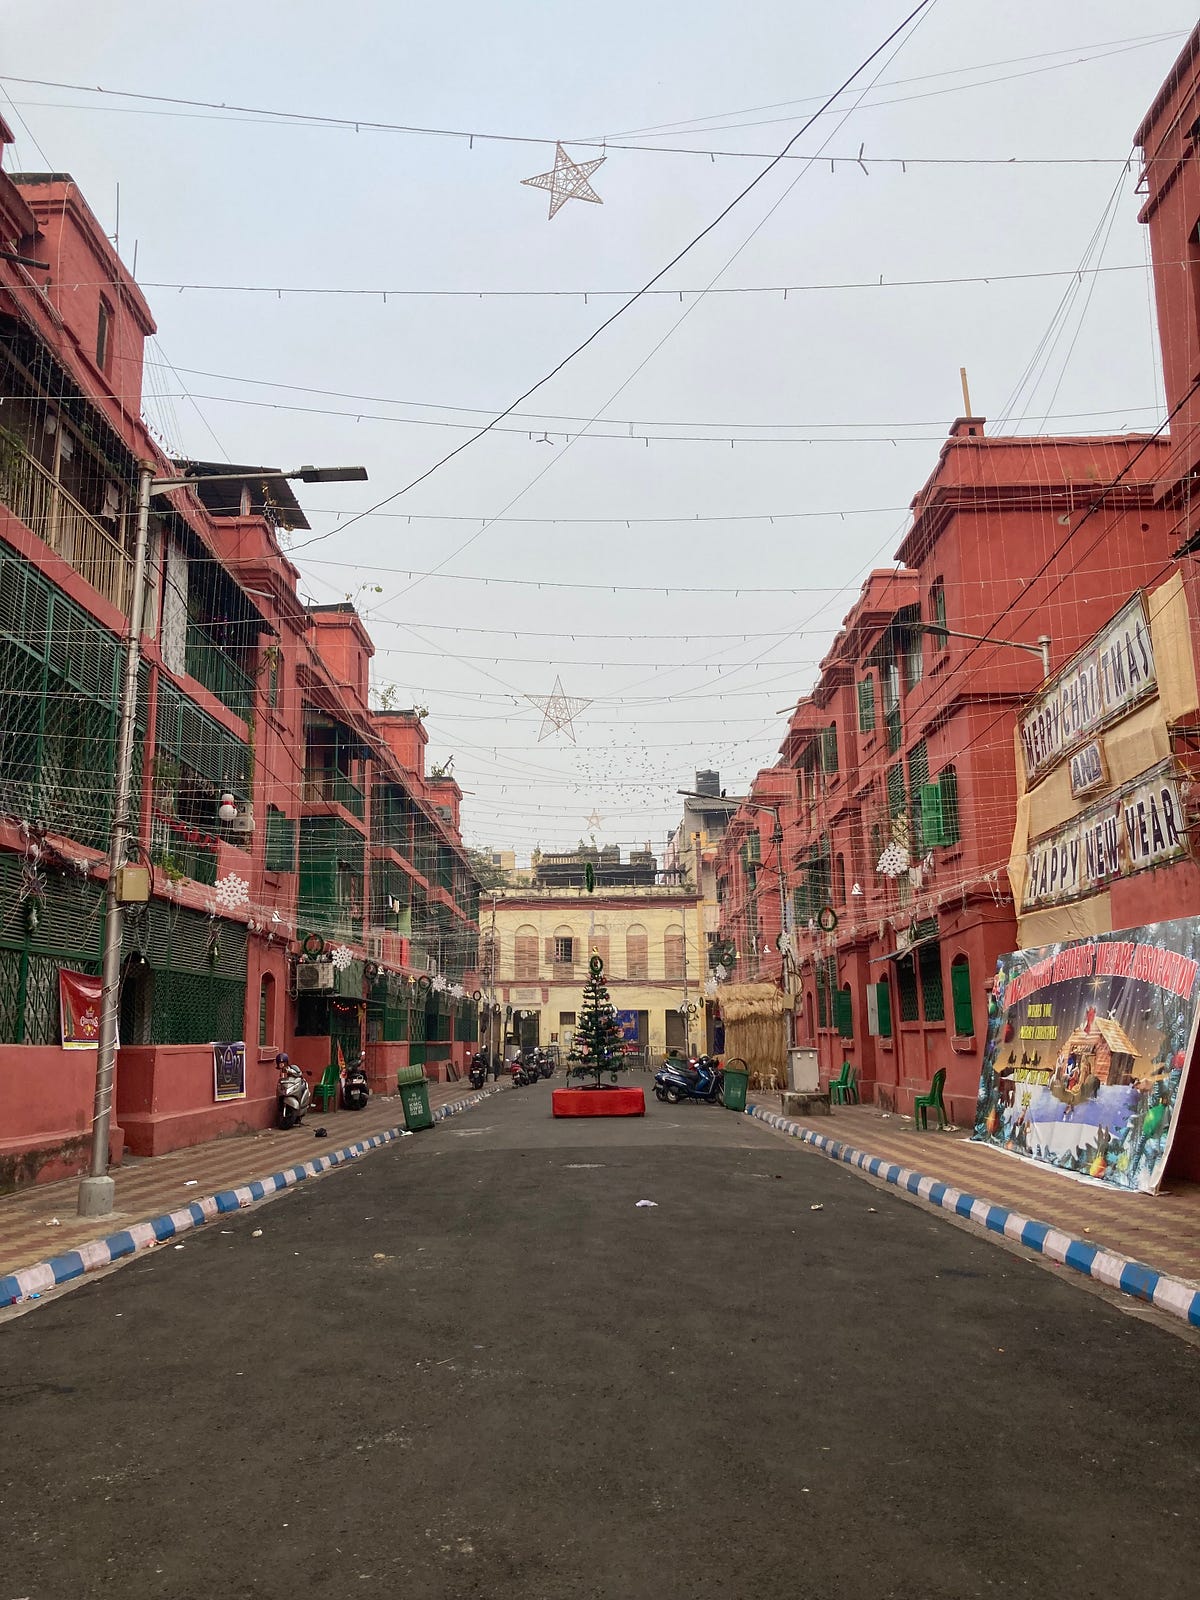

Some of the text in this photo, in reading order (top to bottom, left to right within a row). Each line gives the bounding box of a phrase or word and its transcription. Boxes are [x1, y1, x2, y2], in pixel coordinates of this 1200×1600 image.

[1022, 697, 1060, 772] MERRY
[1071, 744, 1102, 789] AND
[1028, 788, 1179, 898] HAPPY NEW YEAR
[1095, 941, 1134, 978] WELFARE
[1132, 944, 1198, 1001] ASSOCIATION
